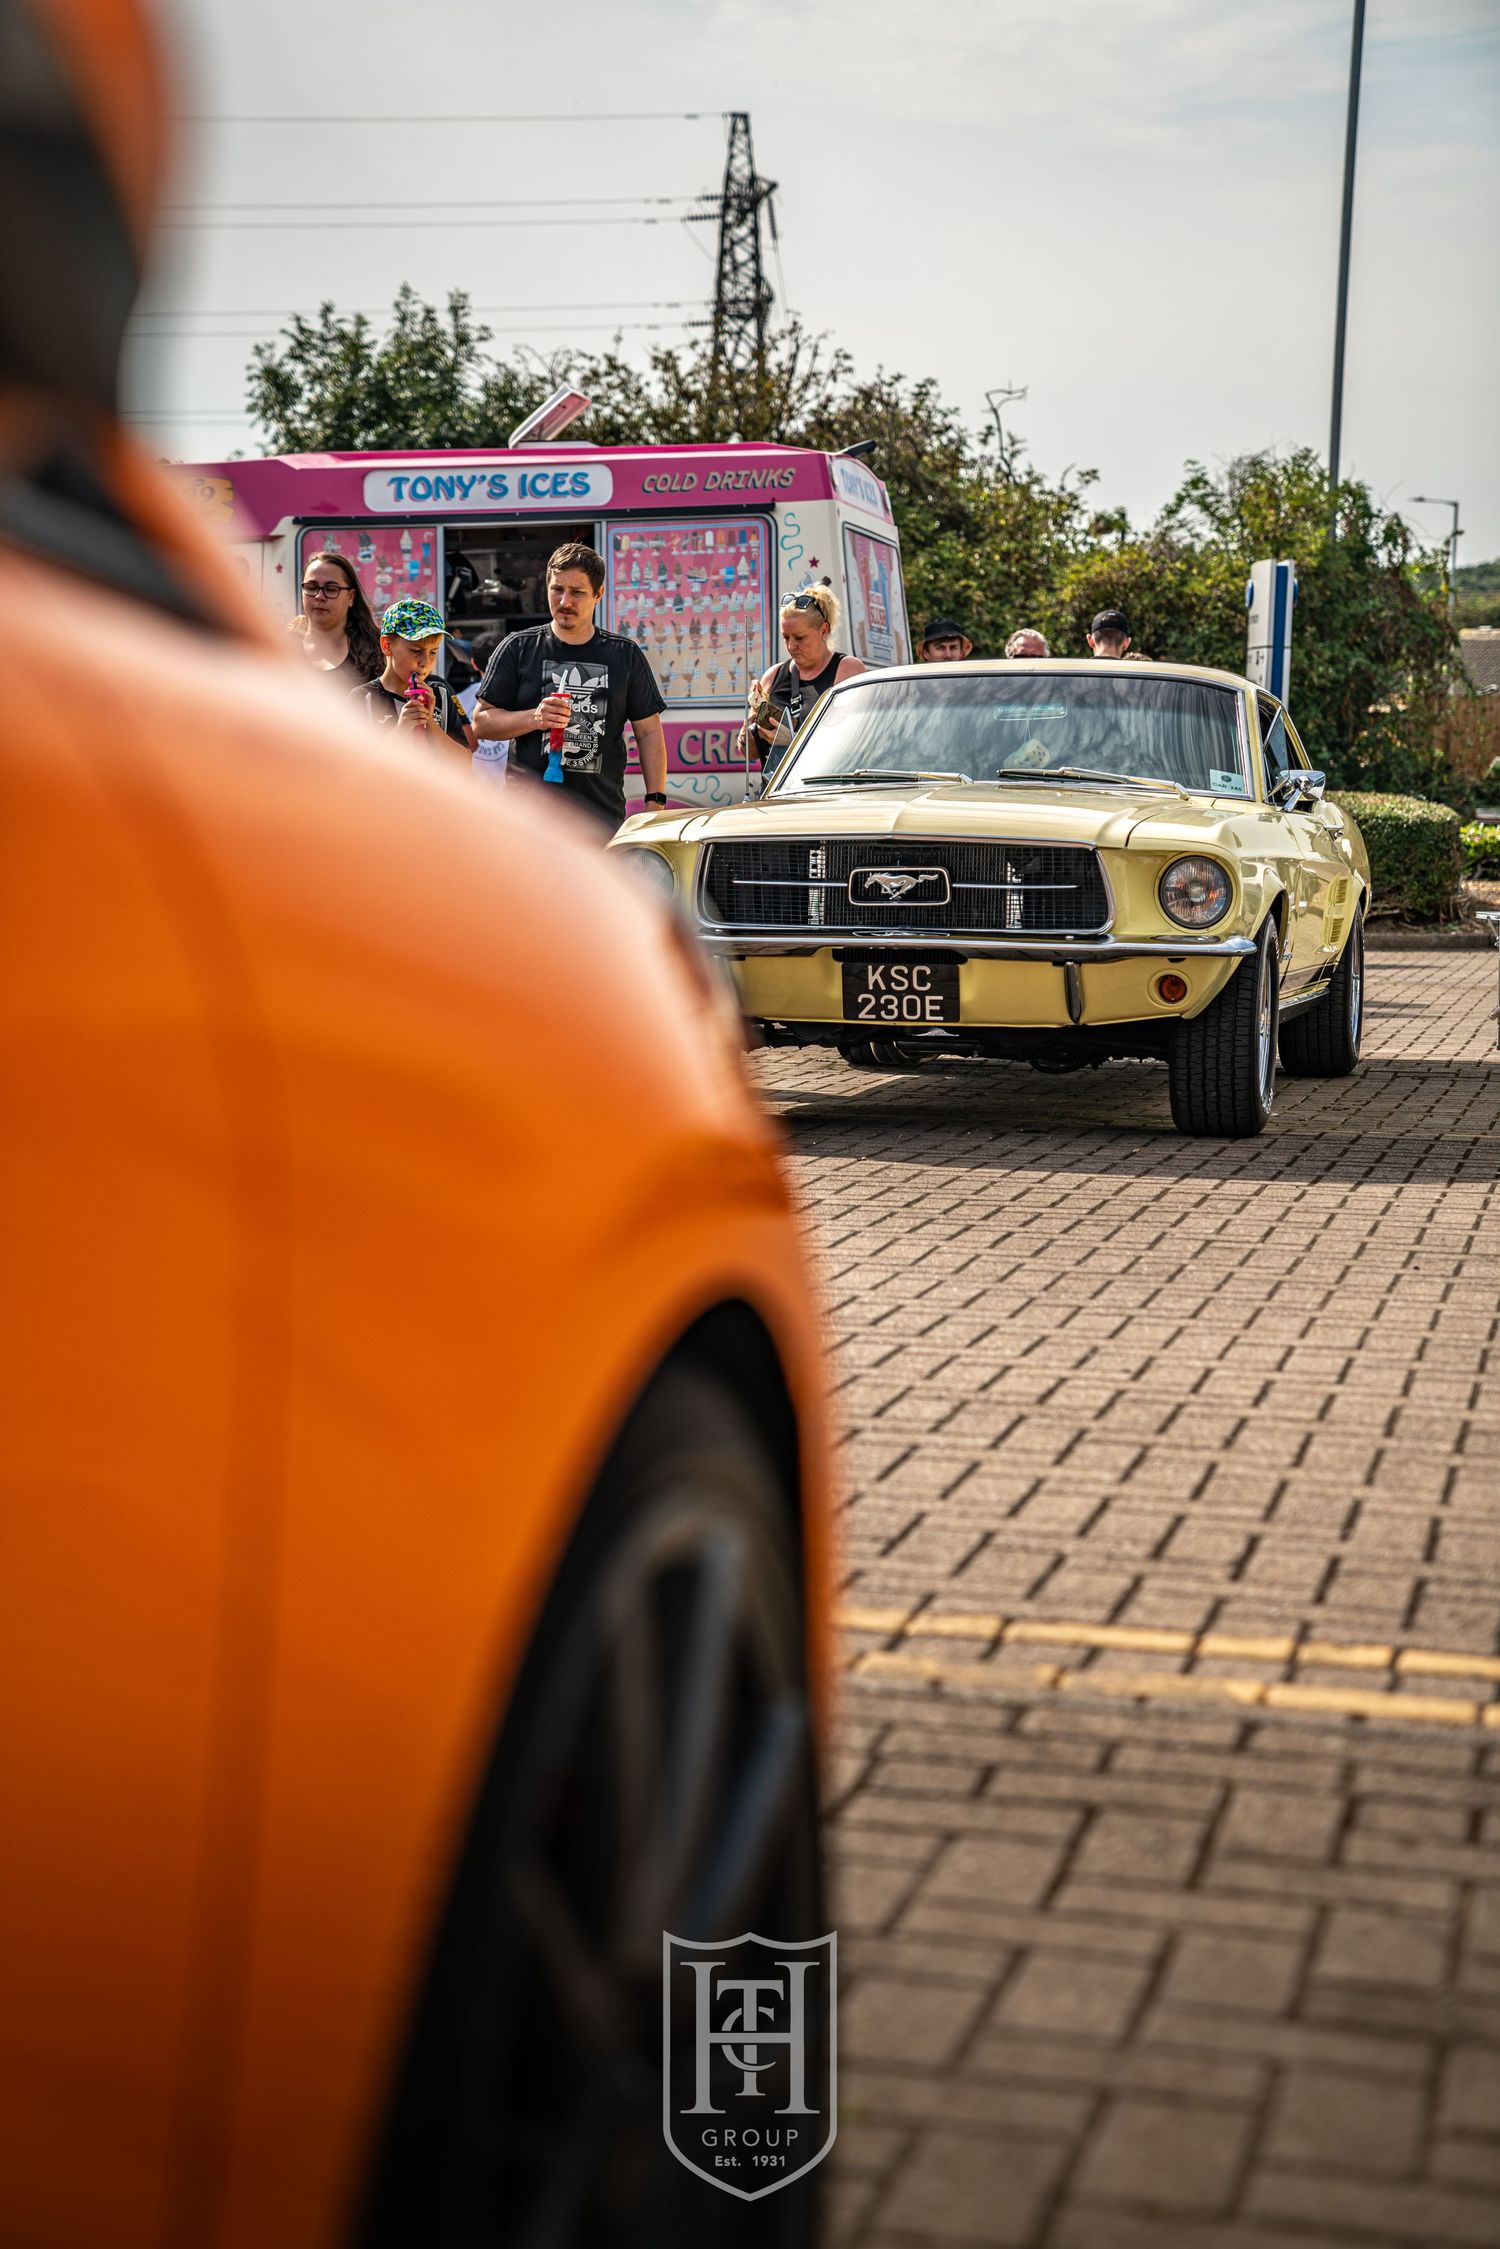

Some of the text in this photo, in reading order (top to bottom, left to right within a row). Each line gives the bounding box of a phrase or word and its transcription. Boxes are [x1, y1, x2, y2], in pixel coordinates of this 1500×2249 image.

[387, 471, 592, 503] TONY'S ICES
[641, 466, 796, 494] COLD DRINKS
[867, 965, 932, 992] KSC
[857, 993, 944, 1021] 230E
